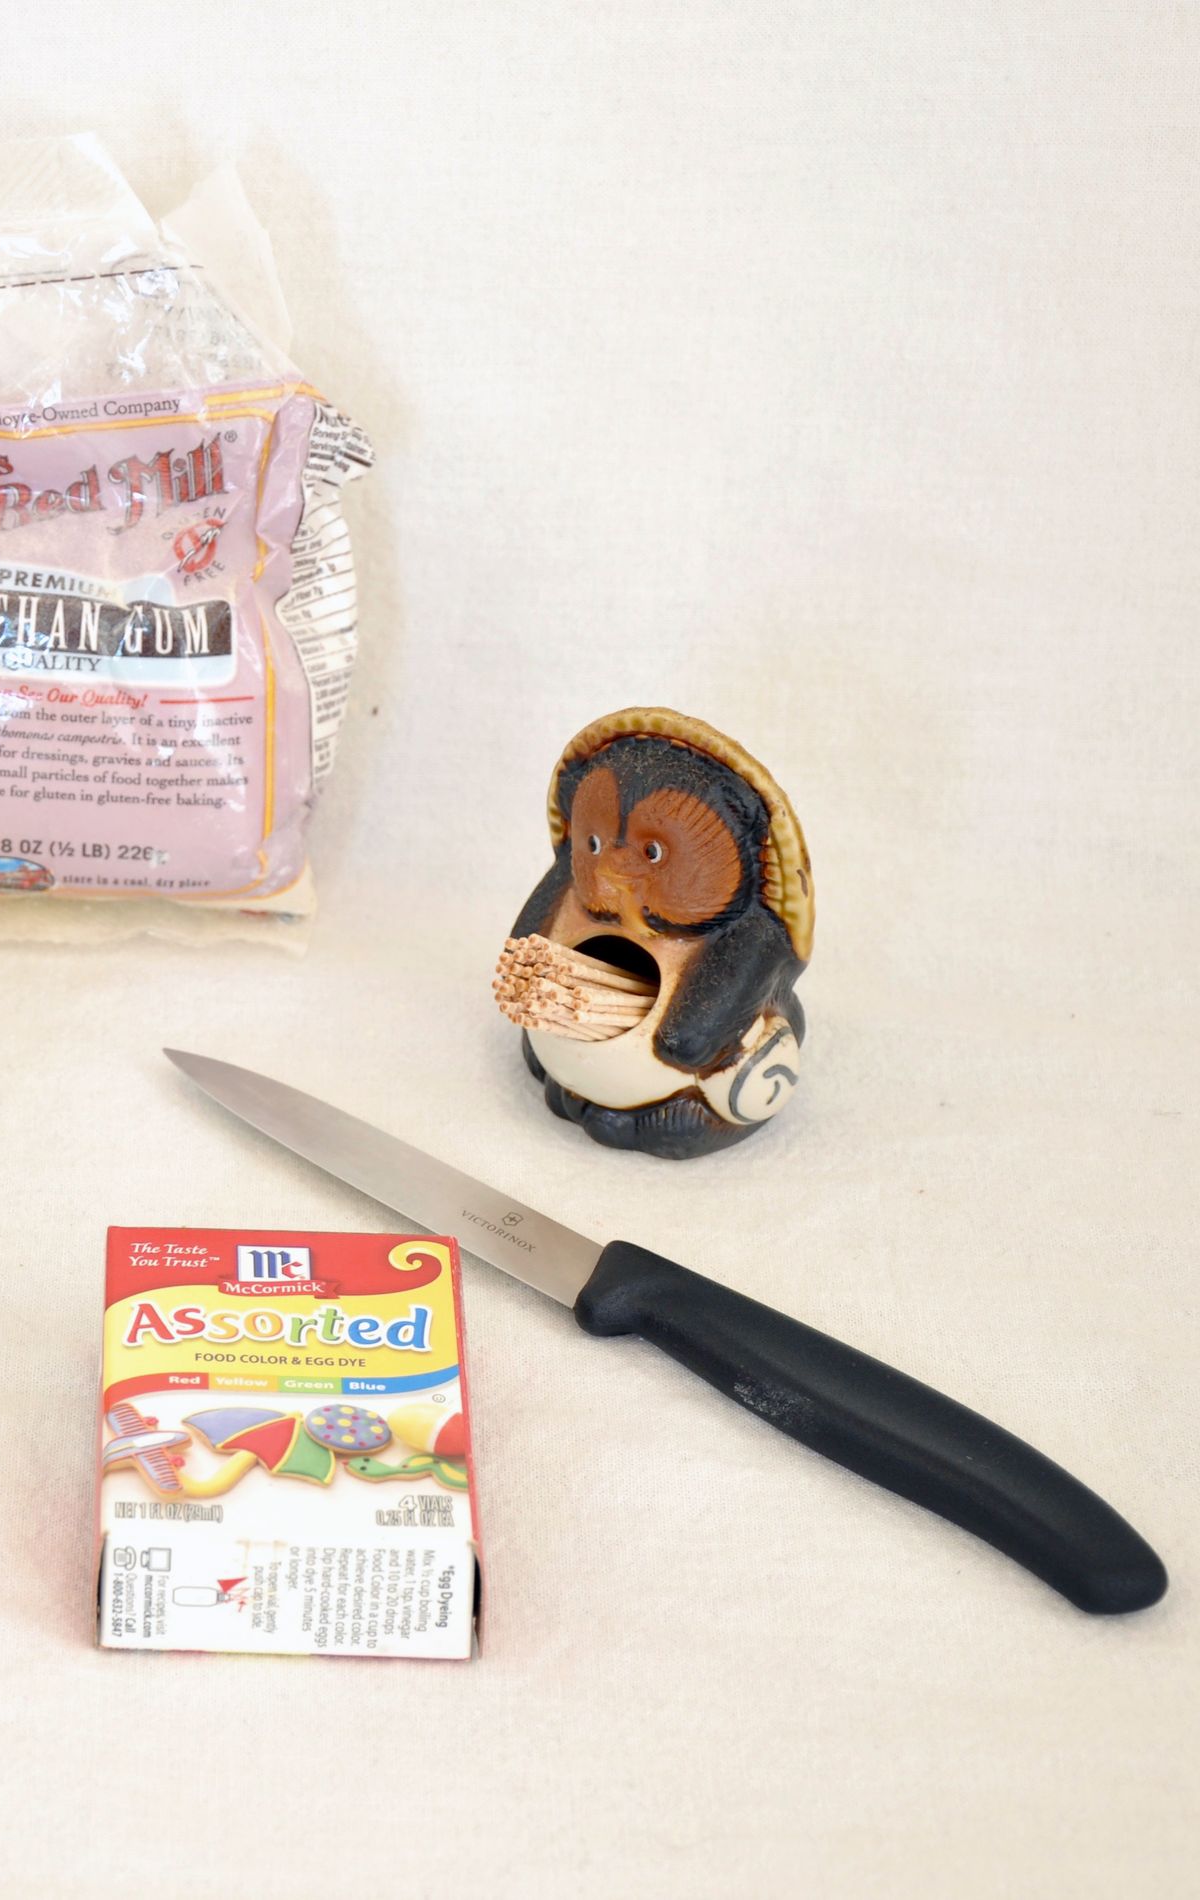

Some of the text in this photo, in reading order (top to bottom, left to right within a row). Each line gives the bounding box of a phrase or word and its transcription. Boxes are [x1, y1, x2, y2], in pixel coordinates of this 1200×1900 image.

[103, 398, 182, 416] Company
[183, 560, 226, 586] FREE
[124, 604, 211, 656] GUM
[2, 649, 101, 672] QUALITY
[47, 687, 79, 704] Our
[82, 688, 149, 710] Quality!
[35, 707, 57, 722] the
[61, 713, 98, 725] outer
[101, 711, 136, 731] layer
[139, 713, 155, 727] of
[168, 716, 198, 734] tiny,
[202, 711, 254, 727] inactive
[57, 731, 127, 747] campestris.
[131, 733, 143, 746] It
[146, 734, 158, 747] is
[161, 738, 178, 748] an
[182, 732, 241, 748] excellent
[21, 748, 89, 764] dressings,
[92, 754, 142, 768] gravies
[145, 753, 172, 767] and
[227, 753, 245, 767] Its
[32, 768, 90, 784] particles
[93, 771, 108, 784] of
[110, 772, 142, 786] food
[145, 774, 203, 790] together
[206, 773, 250, 787] makes
[9, 786, 31, 799] for
[33, 787, 77, 802] gluten
[80, 788, 94, 802] in
[96, 790, 172, 806] gluten-free
[176, 792, 227, 809] baking.
[1, 838, 13, 853] 8
[19, 839, 43, 855] OZ
[81, 842, 112, 860] LB)
[96, 875, 109, 886] in
[155, 876, 175, 889] dry
[178, 877, 211, 889] place
[461, 1209, 537, 1253] VICTORINOX
[130, 1242, 208, 1256] The Taste
[128, 1255, 159, 1268] You
[223, 1281, 325, 1295] McCormick
[124, 1301, 432, 1351] Assorted
[194, 1352, 367, 1368] FOOD COLOR & EGG DYE
[168, 1375, 386, 1392] Red Yellow Green Blue
[114, 1501, 138, 1519] NET
[139, 1502, 147, 1519] 1
[150, 1502, 163, 1520] FL
[166, 1503, 182, 1520] OZ
[398, 1495, 454, 1512] 4 VIALS
[289, 1546, 300, 1557] or
[305, 1546, 318, 1565] into
[371, 1548, 386, 1573] Food
[422, 1549, 436, 1567] Mix
[157, 1574, 170, 1588] For
[302, 1567, 317, 1586] dye
[370, 1574, 384, 1600] Color
[314, 1546, 337, 1649] Dip hard-cooked eggs
[334, 1547, 353, 1647] Repeat for each color.
[350, 1547, 367, 1647] achieve desired color.
[384, 1549, 401, 1636] and 10 to 20 drops
[418, 1580, 431, 1599] cup
[111, 1572, 124, 1638] 1-800-632-5847
[123, 1571, 138, 1634] Questions? Call
[143, 1574, 154, 1638] mccormick.com
[302, 1594, 316, 1632] minutes
[435, 1591, 454, 1629] Dyeing
[399, 1603, 414, 1640] vinegar
[415, 1600, 432, 1633] boiling
[155, 1621, 167, 1636] visit
[367, 1619, 379, 1638] cup
[366, 1638, 378, 1649] to
